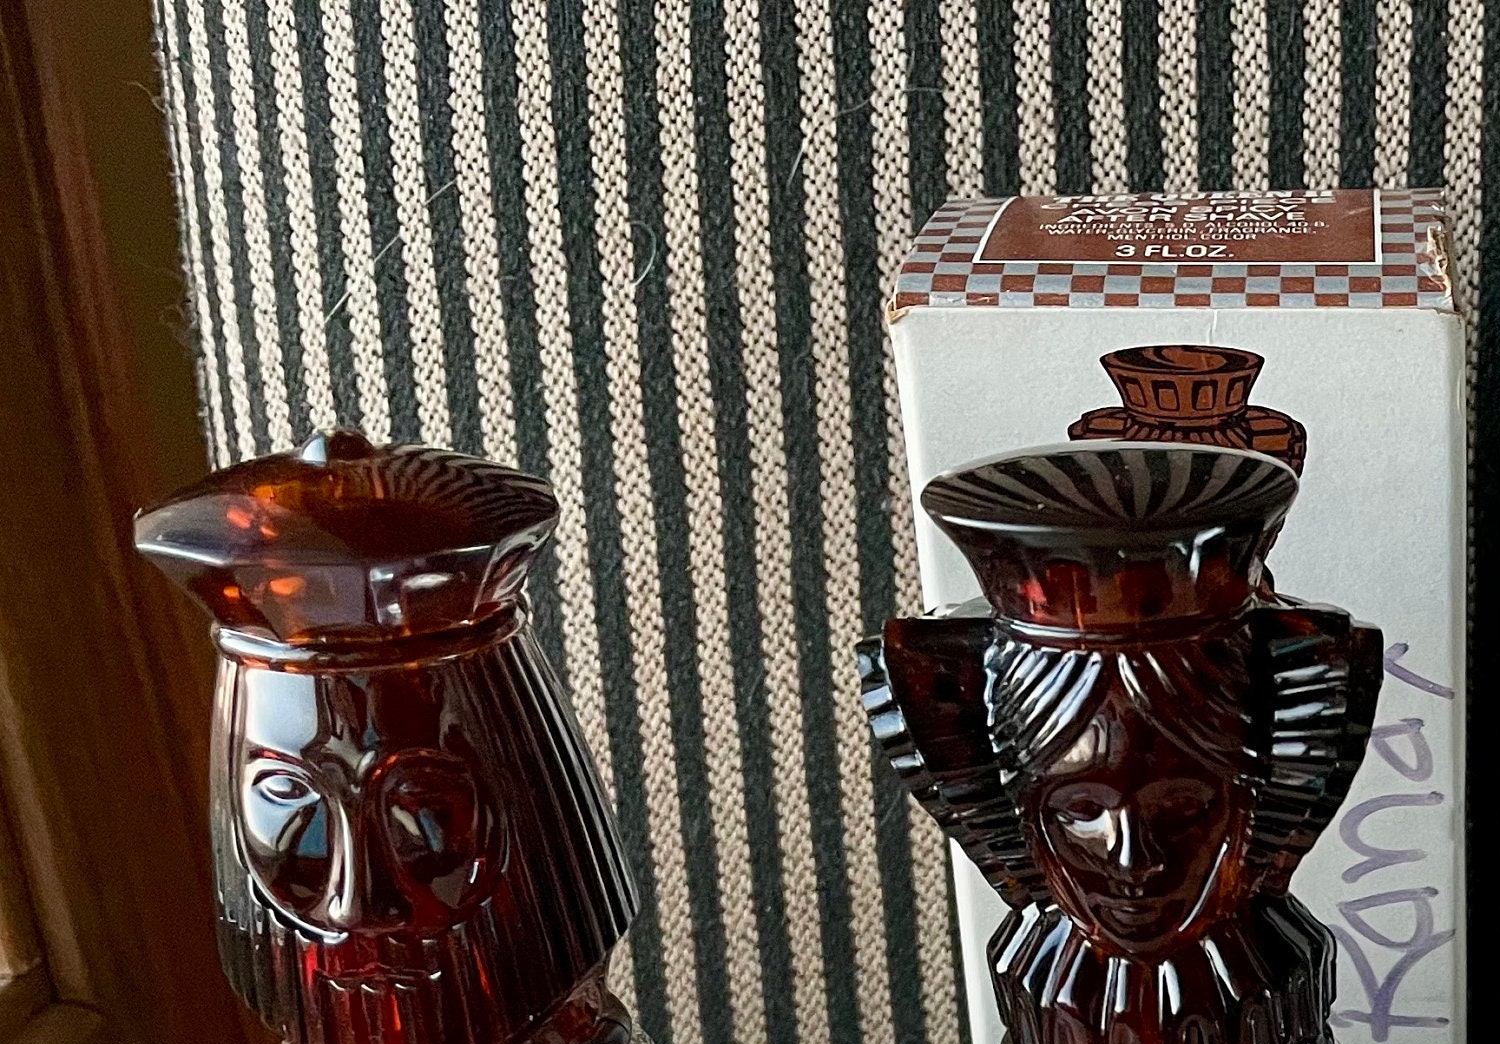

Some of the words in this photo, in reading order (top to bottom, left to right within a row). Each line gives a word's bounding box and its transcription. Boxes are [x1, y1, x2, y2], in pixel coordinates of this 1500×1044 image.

[1071, 207, 1178, 215] AVON
[1190, 204, 1299, 213] SPICY
[1056, 213, 1172, 223] AFTER
[1183, 212, 1306, 222] SHAVE
[1115, 244, 1136, 257] 3
[1144, 244, 1235, 258] FL.OZ.
